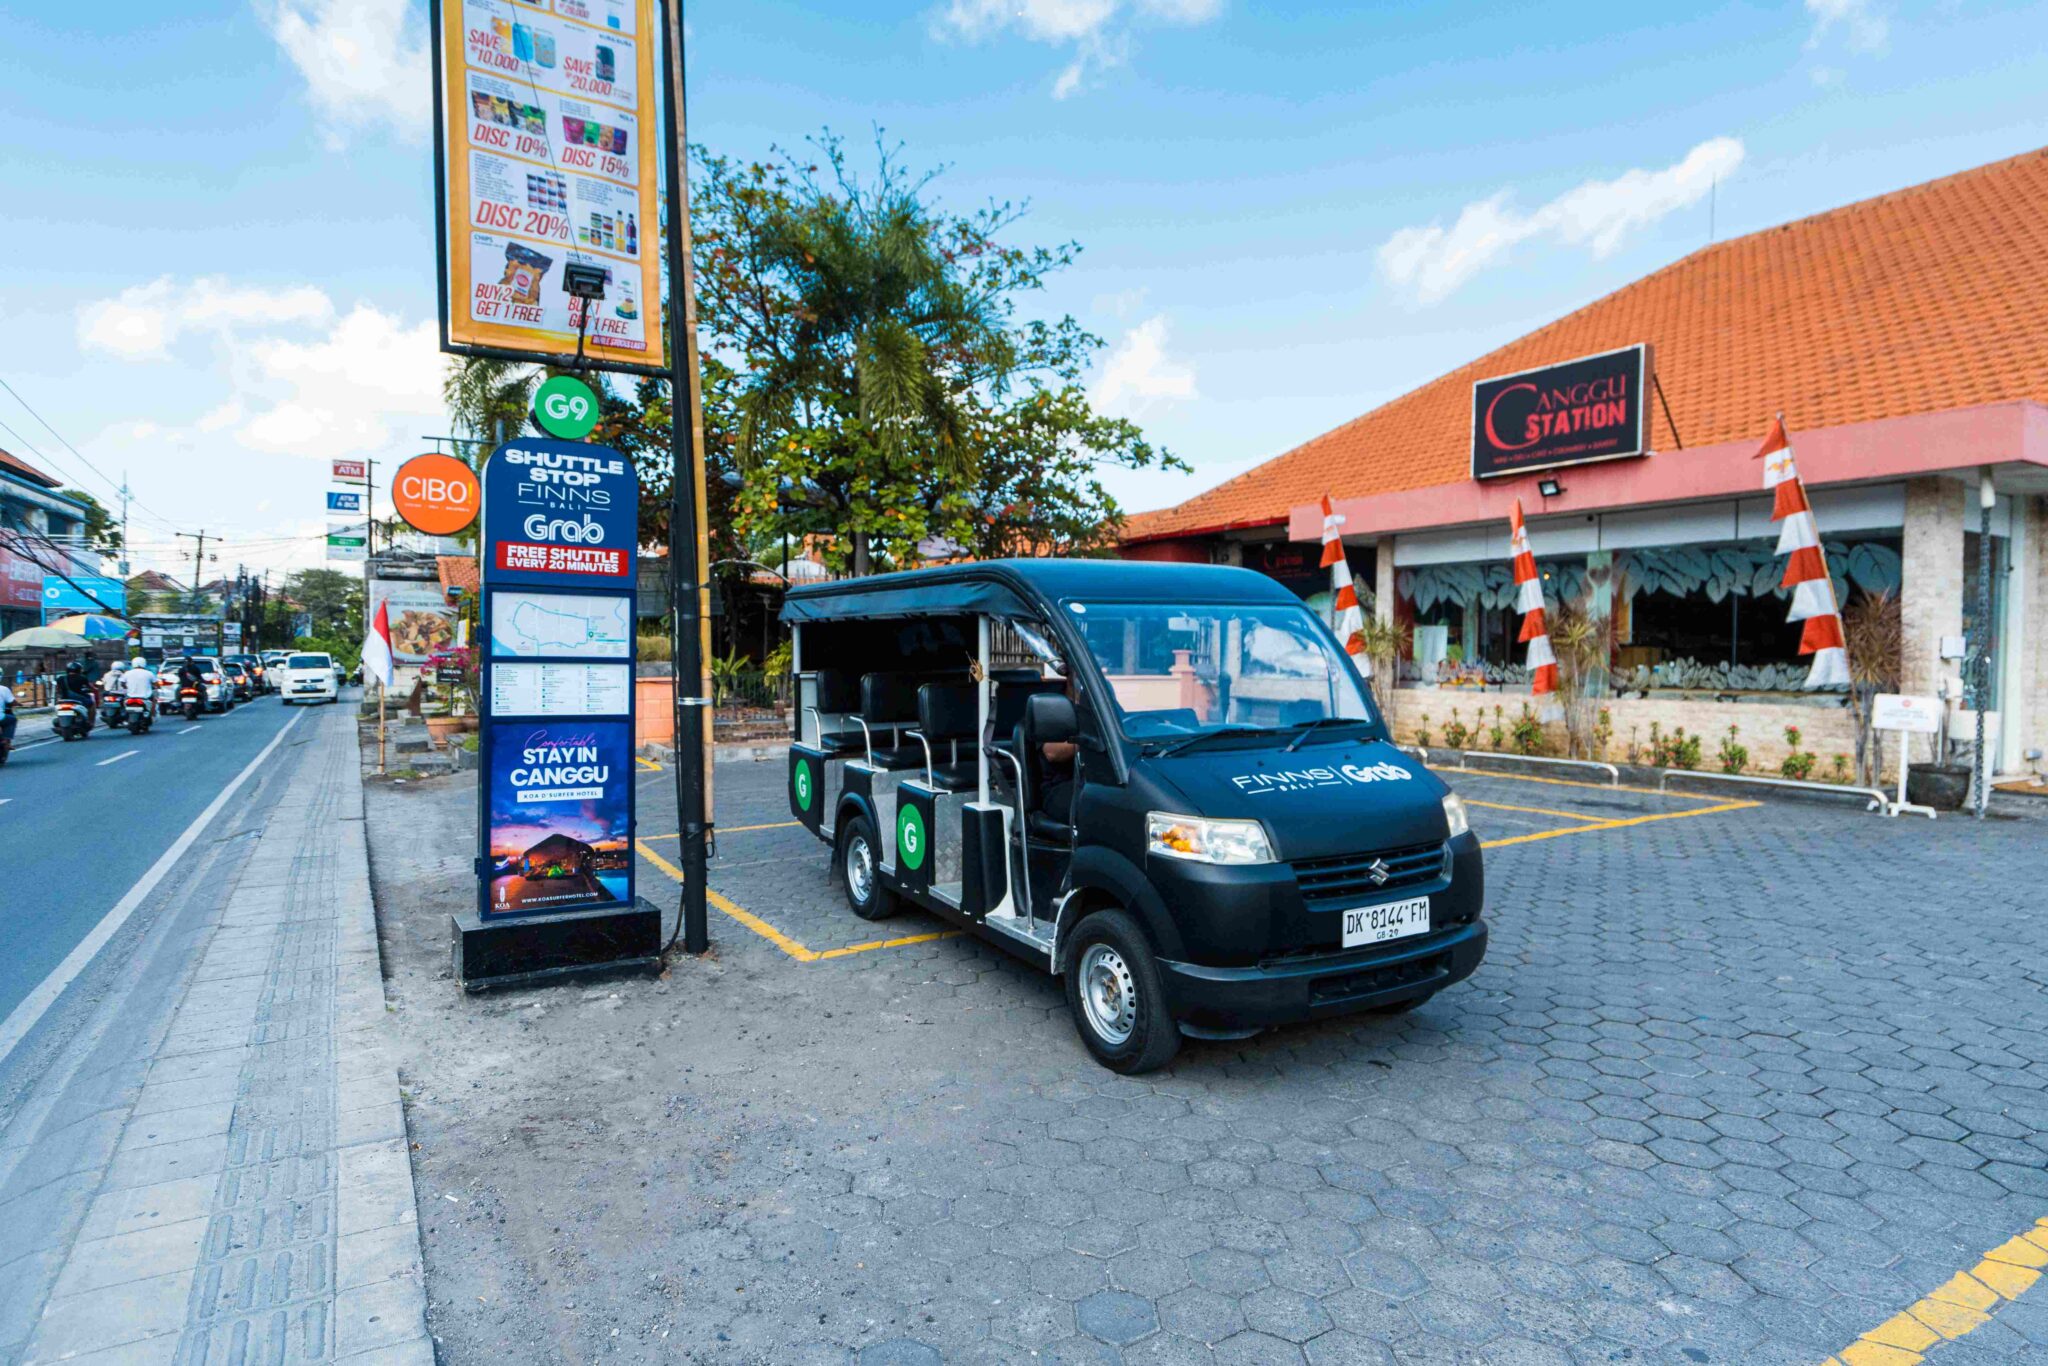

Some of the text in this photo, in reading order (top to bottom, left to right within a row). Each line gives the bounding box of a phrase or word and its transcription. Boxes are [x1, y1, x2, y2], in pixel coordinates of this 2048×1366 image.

[468, 28, 501, 50] SAVE
[564, 55, 594, 76] SAVE
[474, 123, 547, 158] DISC 10%
[561, 146, 629, 178] DISC 15%
[476, 200, 569, 240] DISC 20%
[475, 283, 513, 302] BUY 2
[476, 300, 543, 323] GET 1 FREE
[601, 317, 629, 335] FREE
[545, 393, 588, 421] G9
[1485, 374, 1626, 450] CANGGU
[1524, 399, 1626, 440] STATION
[338, 466, 360, 476] ATM
[505, 448, 624, 475] SHUTTLE
[529, 467, 602, 487] STOP
[402, 476, 472, 504] CIBO!
[518, 482, 611, 504] FINNS
[550, 502, 581, 511] BALI
[524, 513, 604, 544] Grab
[507, 544, 619, 563] FREE SHUTTLE
[506, 557, 619, 573] EVERY 20 MINUTES
[524, 729, 596, 750] Comfortable
[523, 747, 597, 764] STAY IN
[510, 766, 609, 786] CANGGU
[798, 774, 807, 797] G
[1232, 761, 1412, 789] FINNS Grab
[1279, 783, 1314, 791] BALI
[904, 822, 917, 853] G
[494, 902, 510, 910] KOA
[1346, 901, 1427, 934] DK 8144 FM
